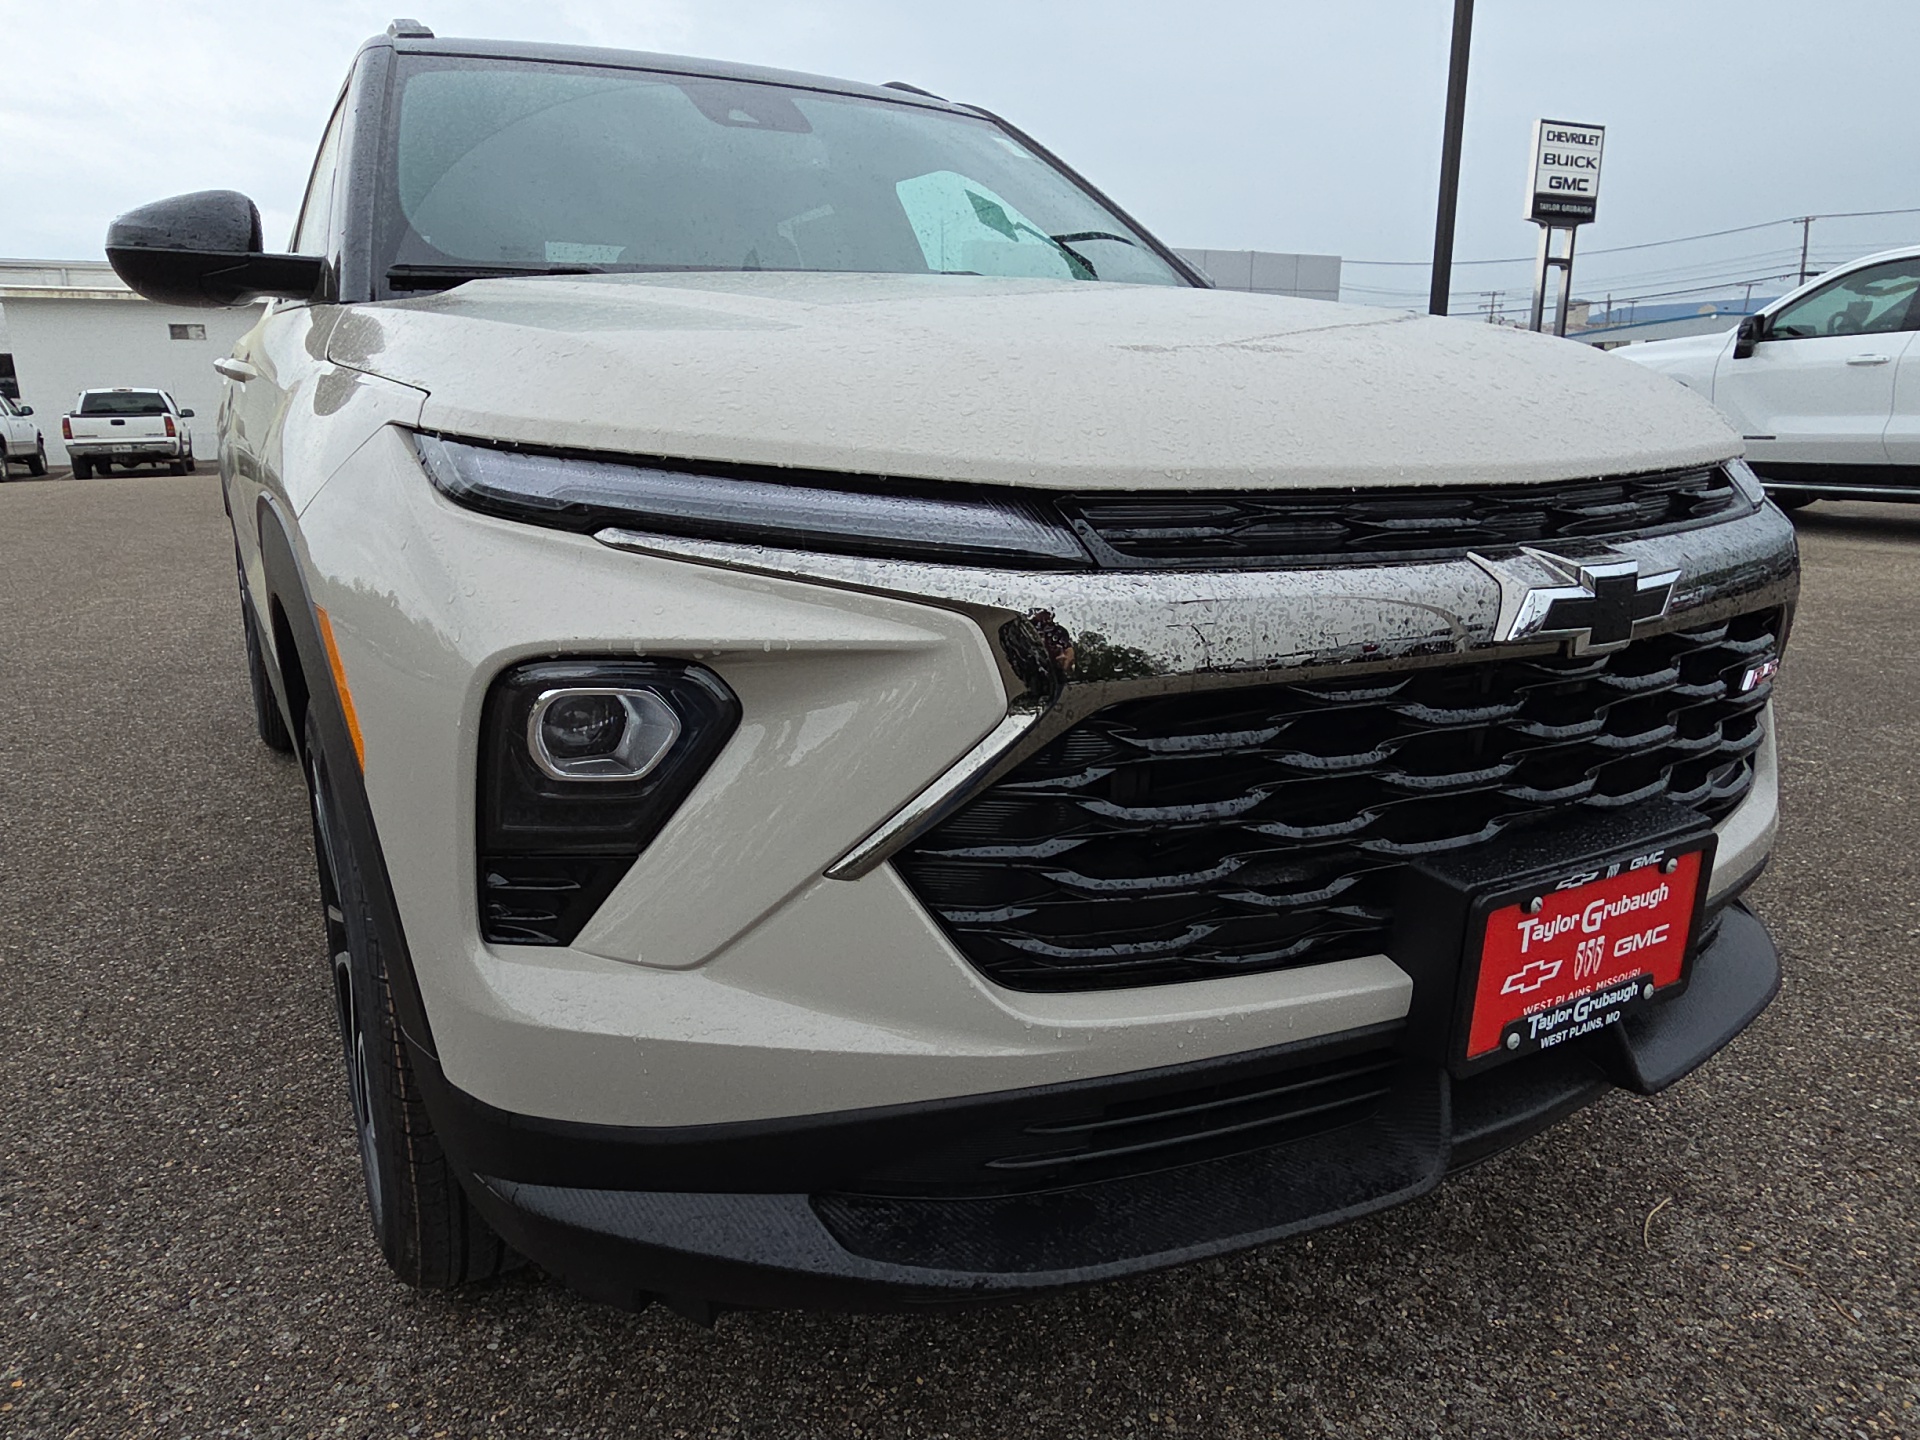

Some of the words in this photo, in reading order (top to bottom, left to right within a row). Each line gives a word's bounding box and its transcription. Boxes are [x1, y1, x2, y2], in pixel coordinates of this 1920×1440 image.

[1546, 130, 1600, 146] CHEVROLET
[1543, 152, 1597, 169] BUICK
[1549, 175, 1589, 191] GMC
[1629, 850, 1665, 871] GMC
[1517, 913, 1580, 953] Taylor
[1581, 882, 1669, 934] Grubaugh
[1613, 923, 1670, 957] GMC
[1527, 1008, 1573, 1040] Taylor
[1573, 981, 1639, 1023] Grubaugh
[1540, 1029, 1568, 1049] WEST
[1569, 1017, 1603, 1039] PLAINS,
[1605, 1010, 1621, 1025] MO
